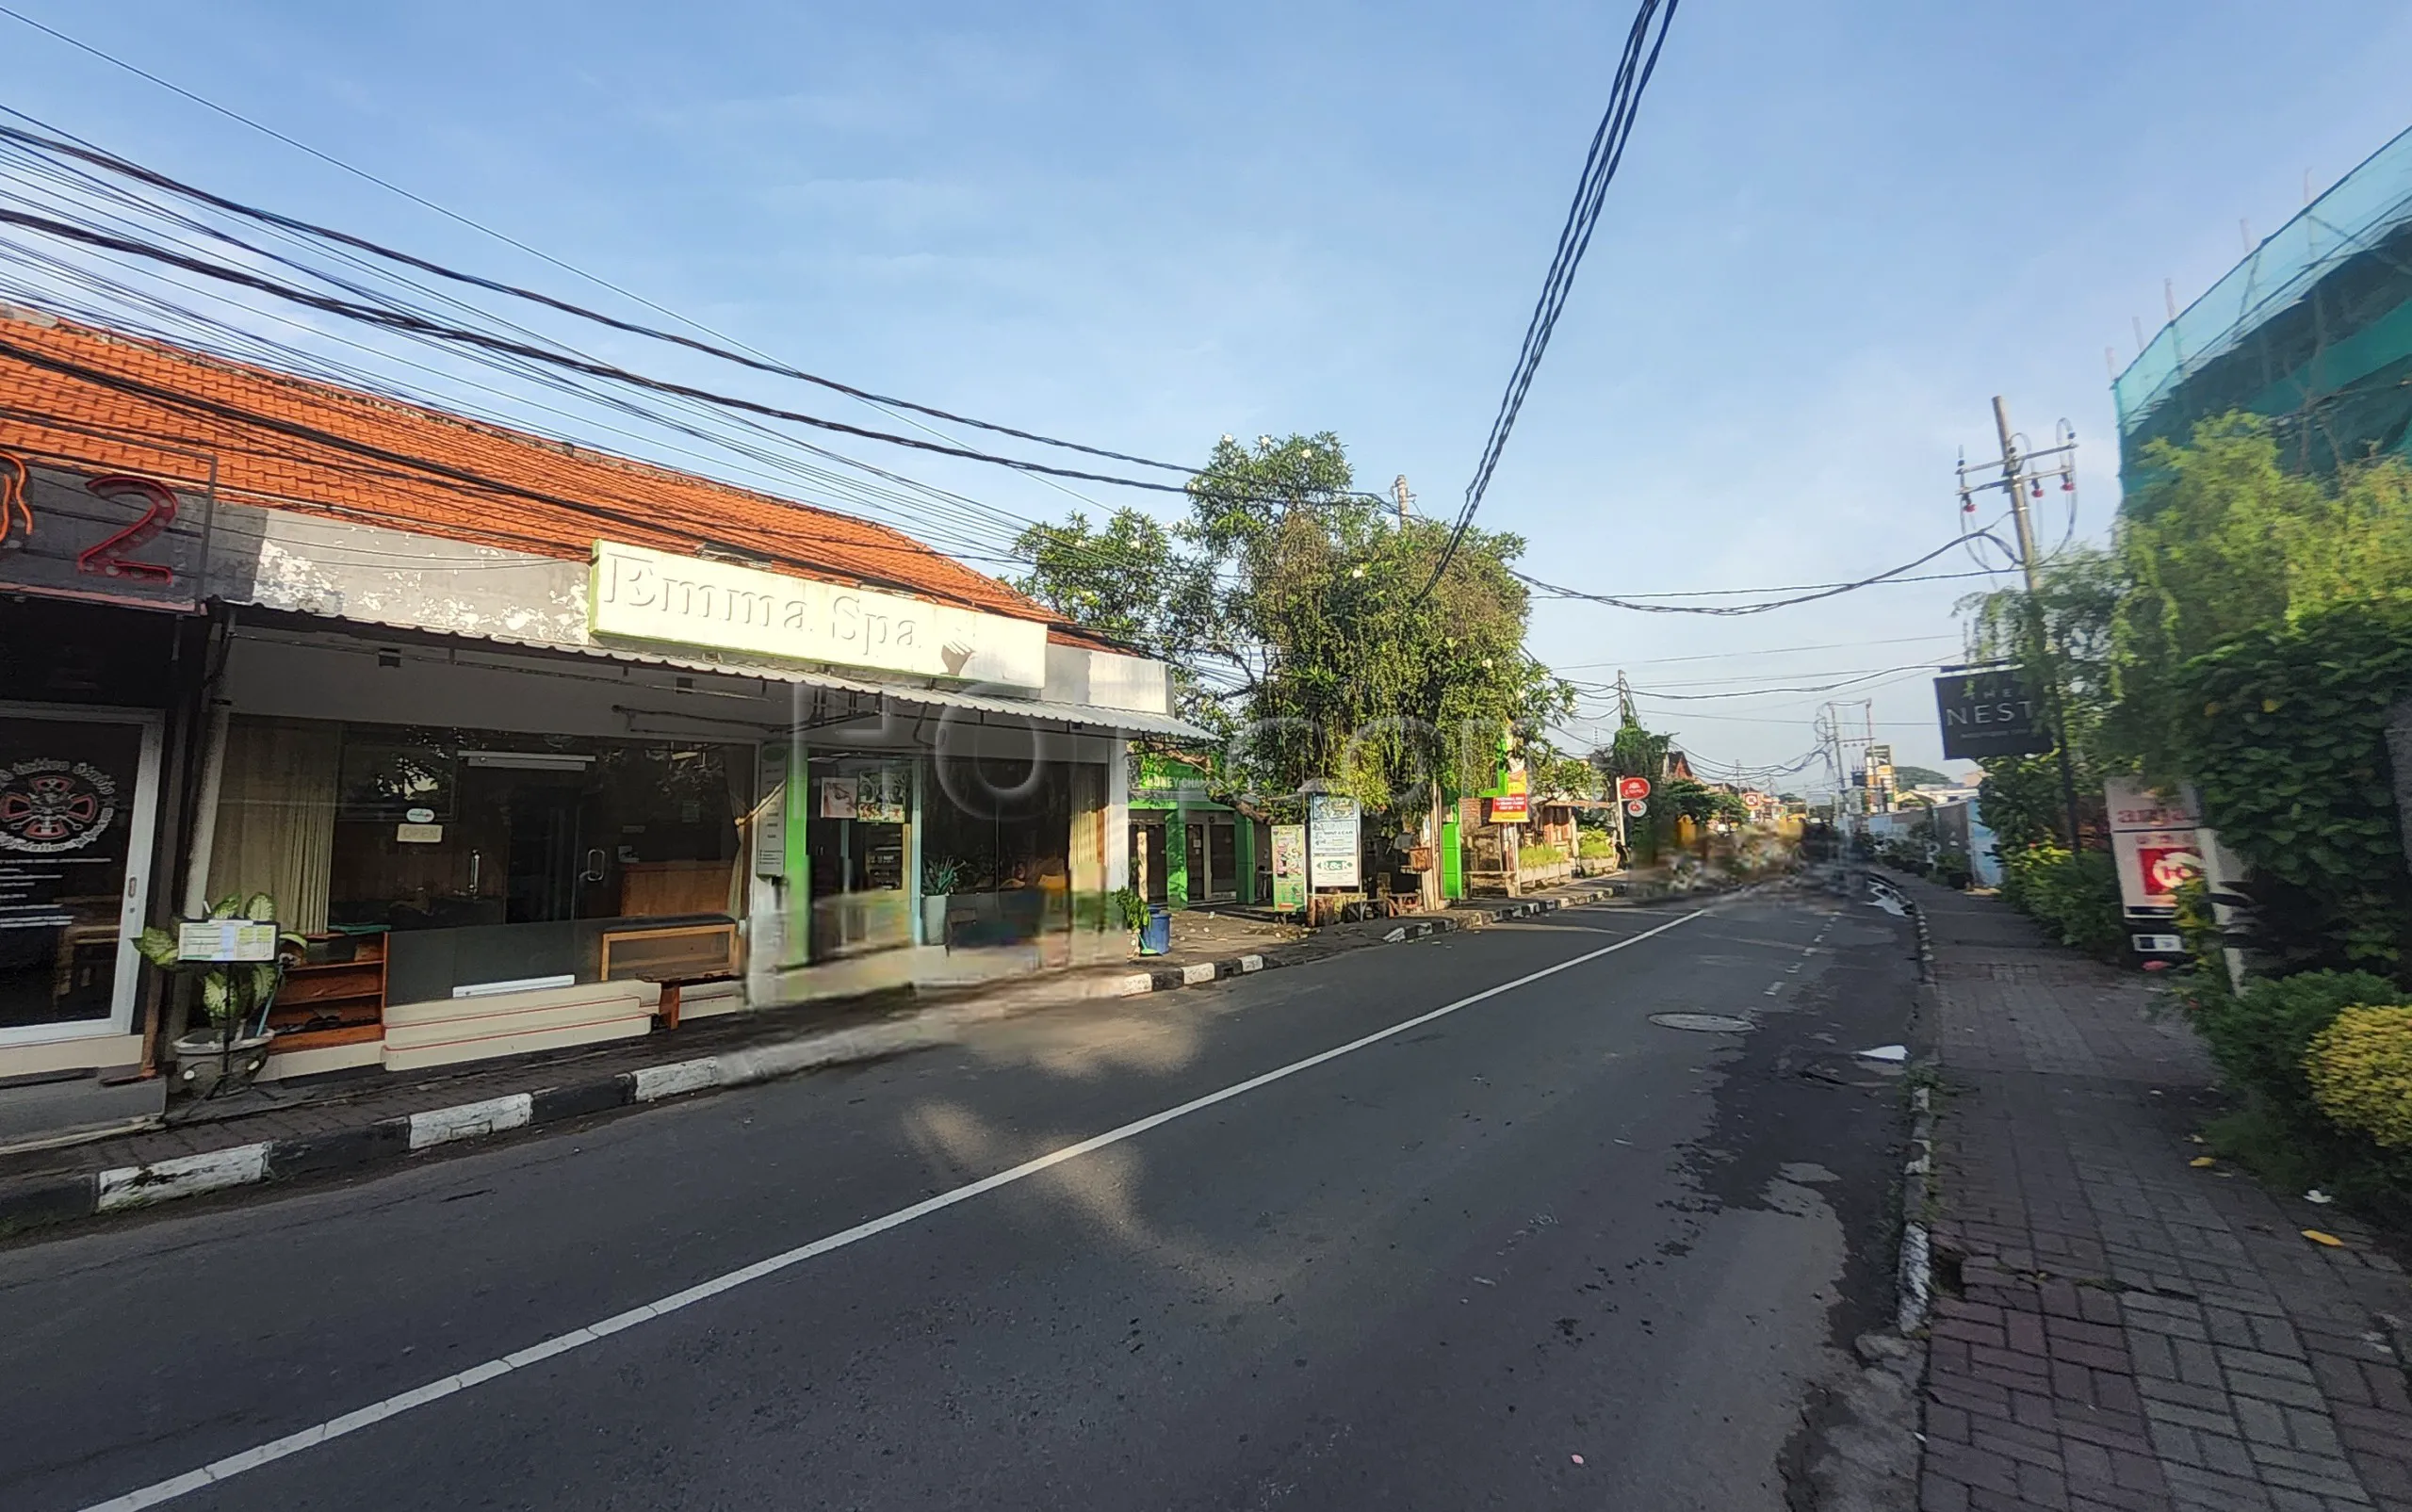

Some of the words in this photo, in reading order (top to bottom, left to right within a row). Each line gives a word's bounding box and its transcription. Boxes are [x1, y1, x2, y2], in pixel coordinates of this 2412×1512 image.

[78, 474, 178, 585] 2
[604, 552, 811, 630] Emma
[831, 595, 921, 657] Spa
[1946, 700, 2033, 726] NEST
[402, 827, 439, 838] OPEN
